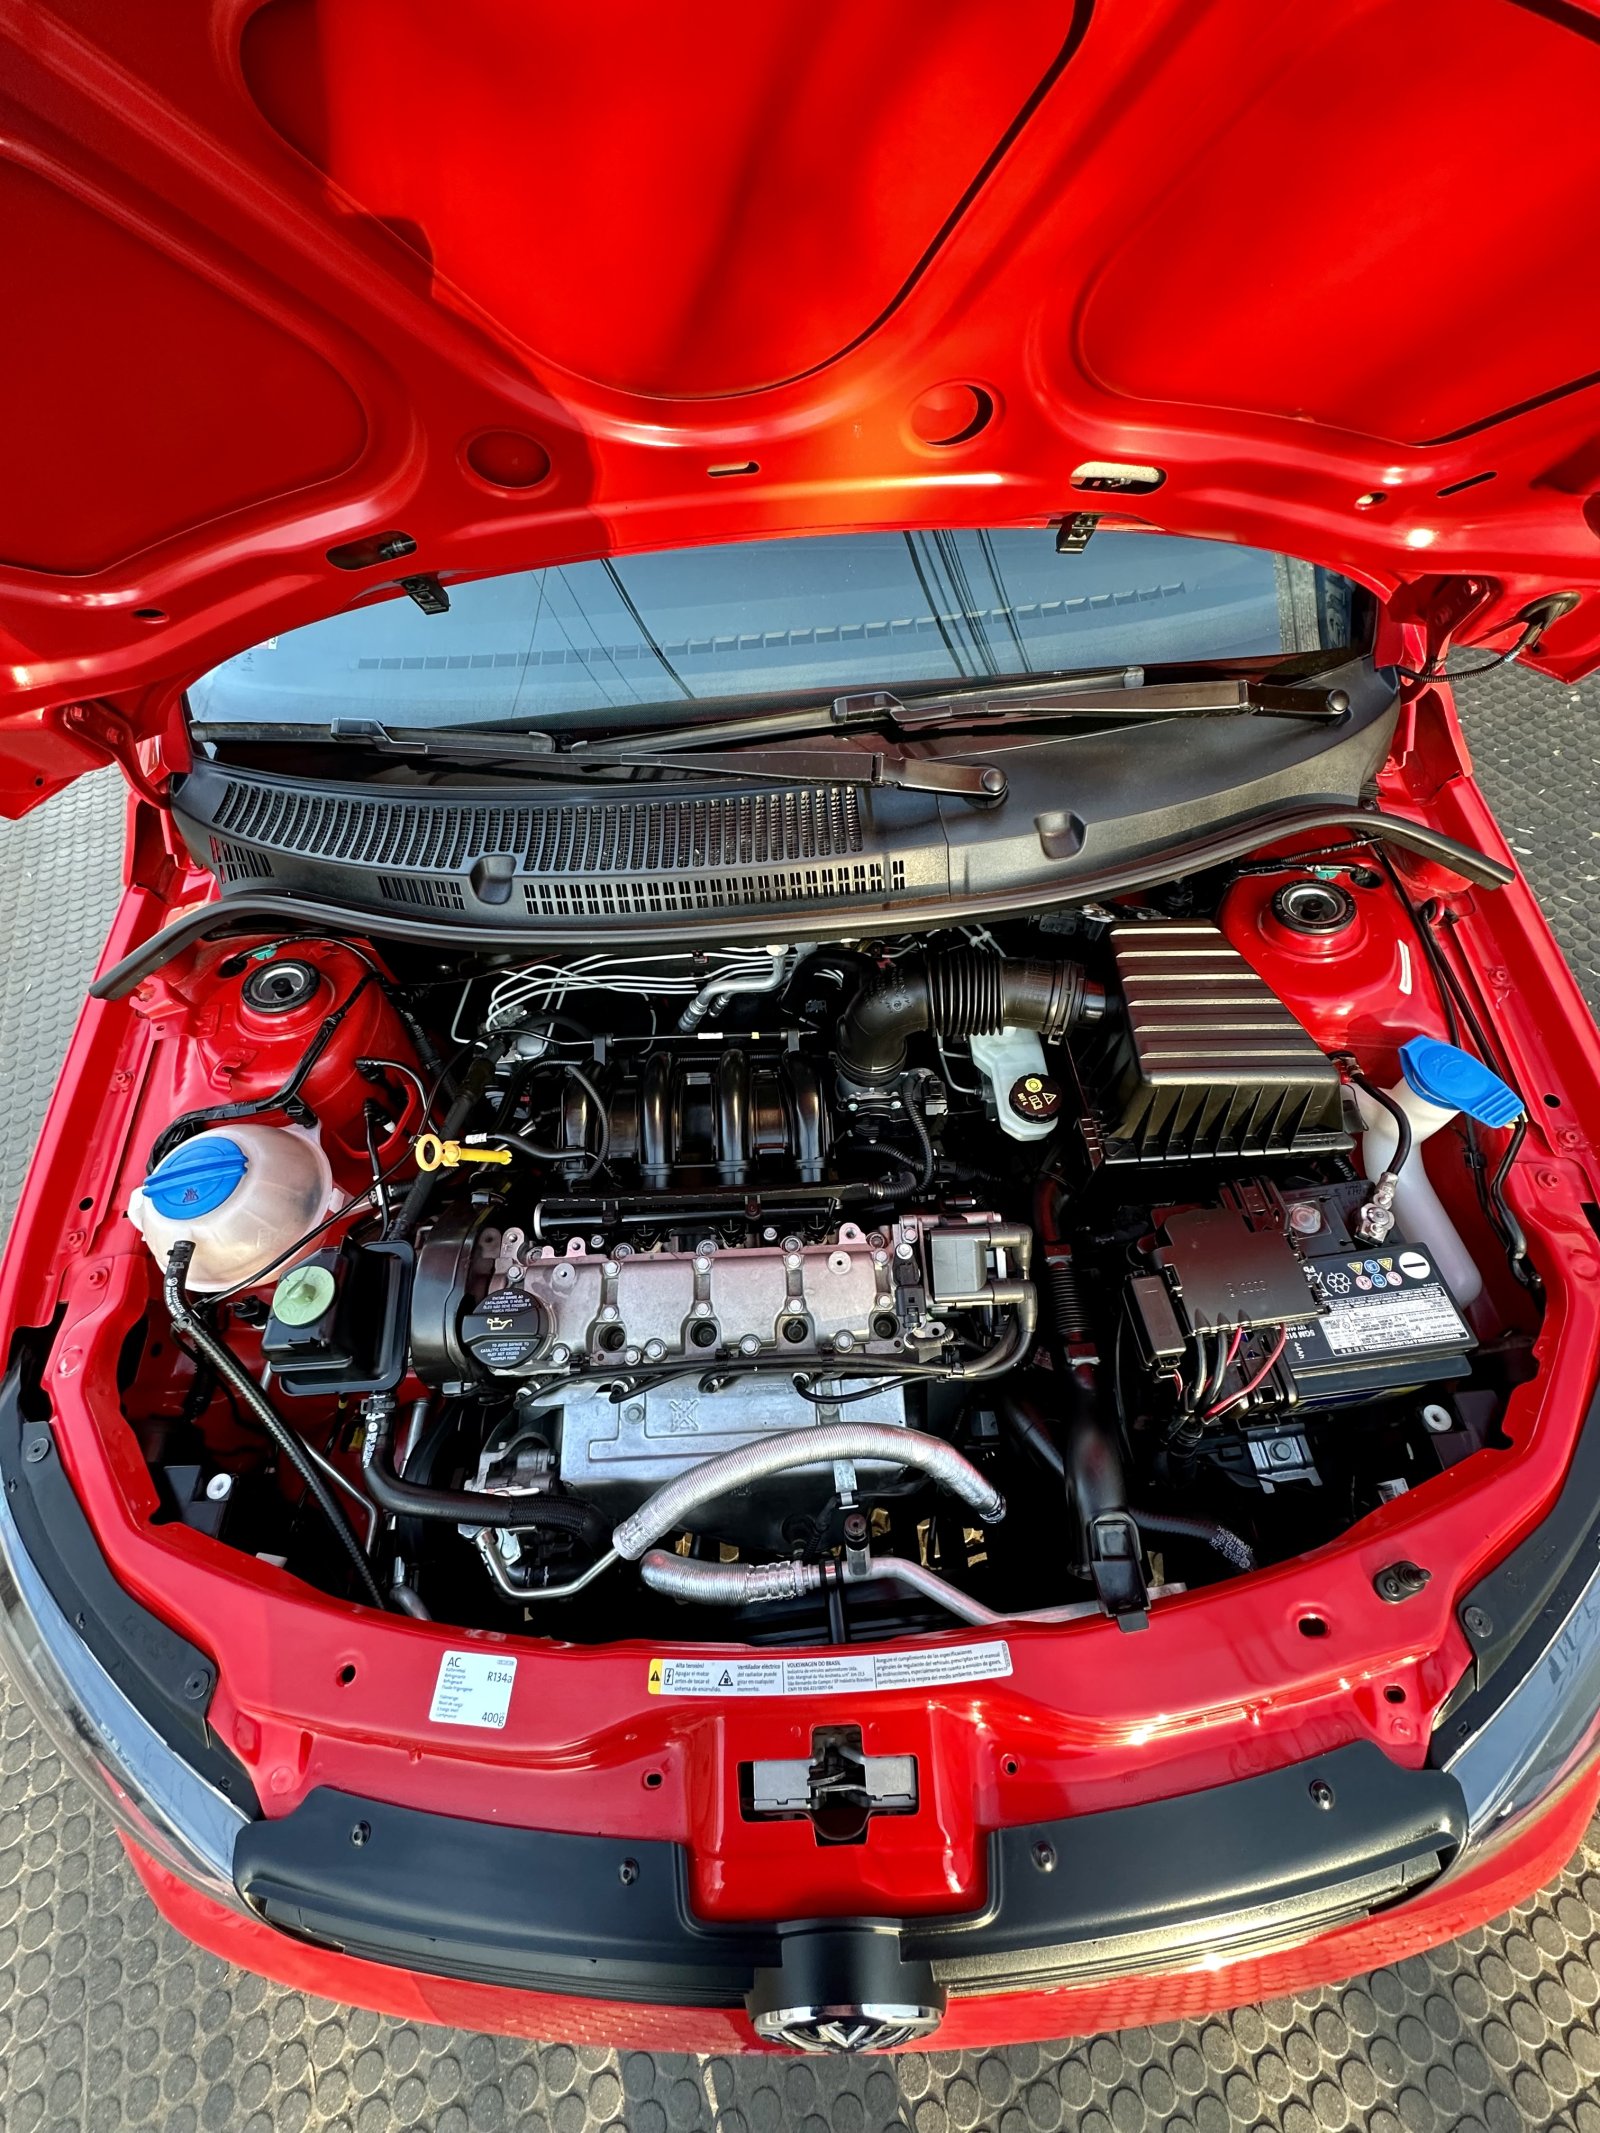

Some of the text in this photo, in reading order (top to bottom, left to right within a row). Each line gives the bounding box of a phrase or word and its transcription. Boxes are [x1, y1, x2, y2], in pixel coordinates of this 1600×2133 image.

[1303, 1265, 1316, 1274] Pb
[447, 1656, 462, 1667] AC
[487, 1671, 513, 1684] R134a
[481, 1712, 505, 1727] 400g
